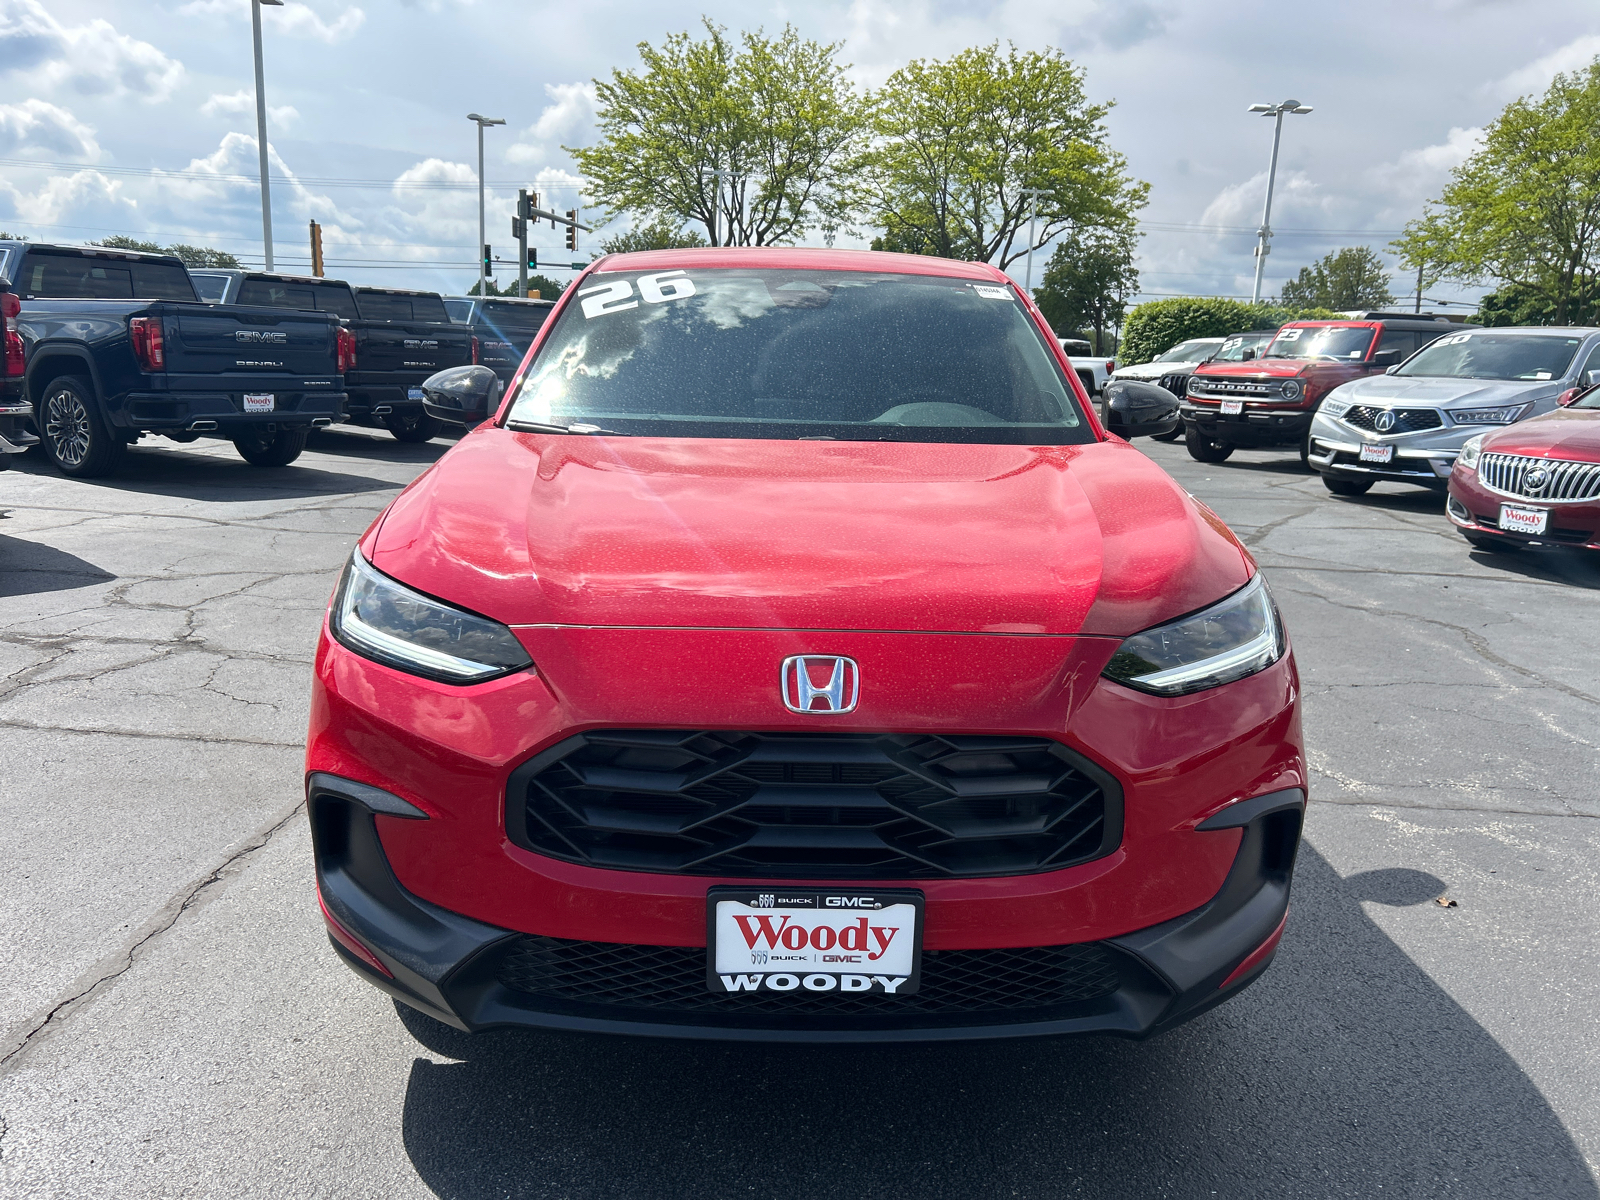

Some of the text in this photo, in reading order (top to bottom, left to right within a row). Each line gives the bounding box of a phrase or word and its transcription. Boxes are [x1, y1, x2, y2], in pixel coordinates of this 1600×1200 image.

[577, 269, 697, 319] 26
[235, 330, 287, 343] GMC
[1275, 328, 1304, 341] 23
[403, 339, 439, 350] GMC
[483, 341, 513, 350] GMC
[1221, 337, 1243, 352] 23
[1207, 383, 1266, 391] BRONCO
[246, 396, 272, 406] Woody
[1364, 446, 1389, 457] Woody
[1505, 509, 1543, 526] Woody
[1500, 524, 1546, 535] WOODY
[825, 896, 875, 907] GMC
[732, 914, 900, 961] Woody
[822, 954, 862, 963] GMC
[719, 973, 908, 994] WOODY
